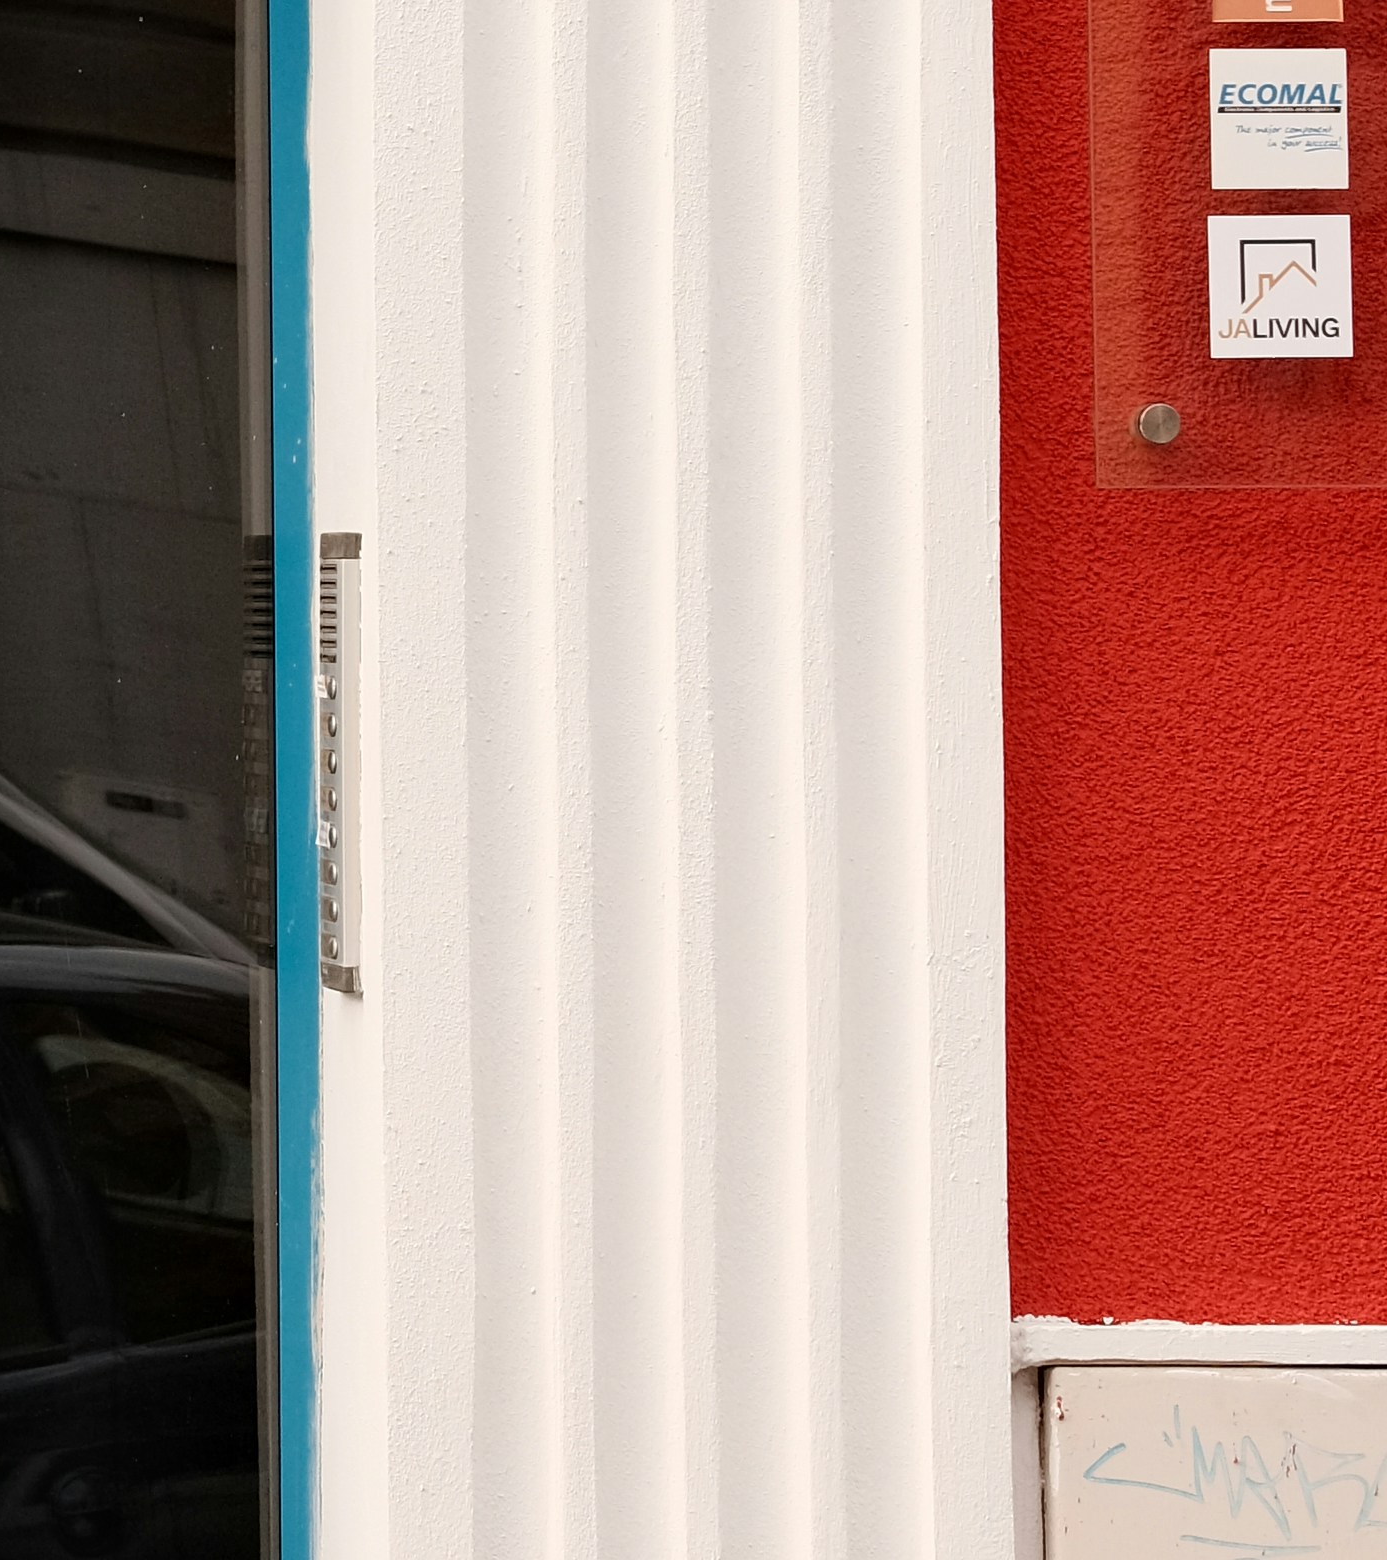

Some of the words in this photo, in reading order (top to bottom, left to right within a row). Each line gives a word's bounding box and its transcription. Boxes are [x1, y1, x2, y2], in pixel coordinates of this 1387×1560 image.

[1219, 83, 1342, 105] ECOMAL
[1235, 124, 1252, 134] The
[1255, 125, 1282, 136] major
[1284, 126, 1332, 135] component
